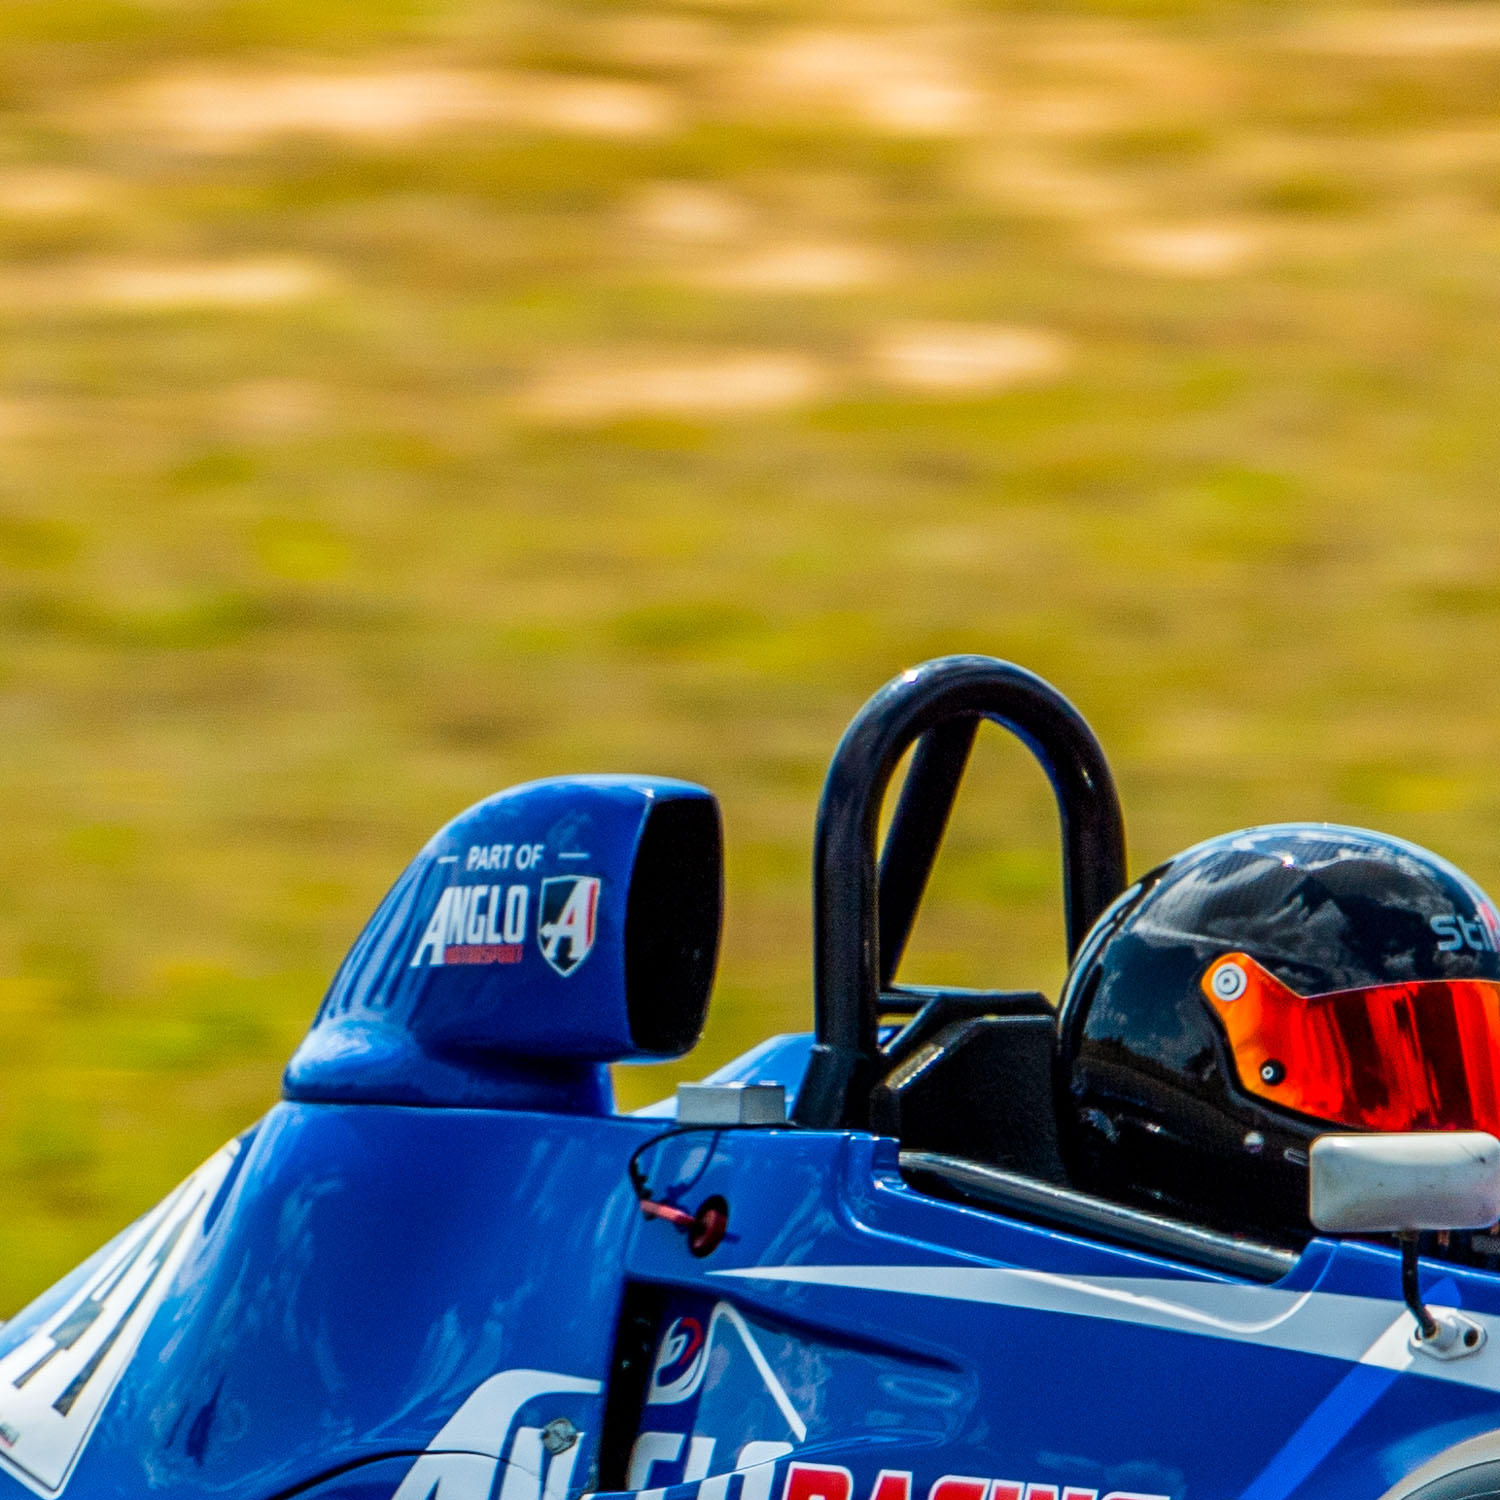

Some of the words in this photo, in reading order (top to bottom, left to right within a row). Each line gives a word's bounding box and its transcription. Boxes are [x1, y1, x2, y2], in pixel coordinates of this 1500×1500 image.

[466, 845, 513, 871] PART
[515, 844, 544, 870] OF
[410, 885, 529, 967] ANGLO
